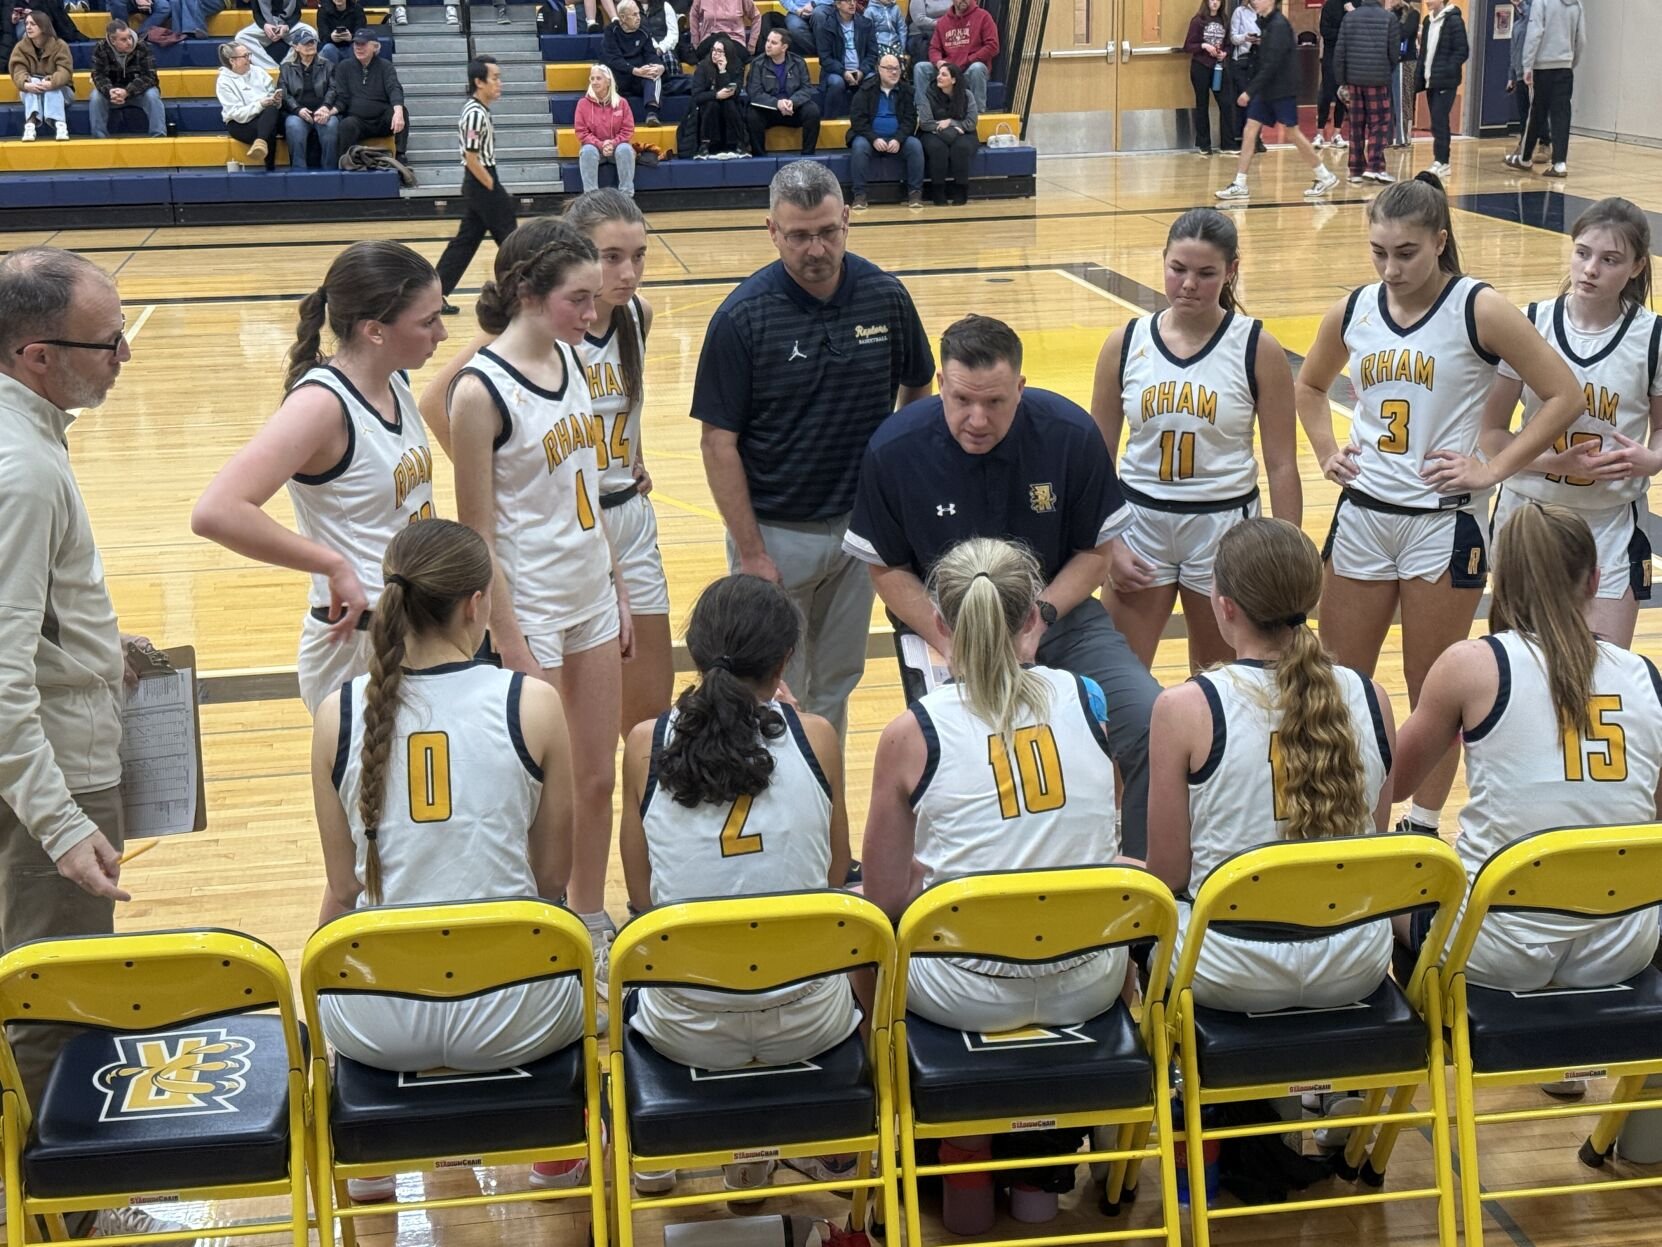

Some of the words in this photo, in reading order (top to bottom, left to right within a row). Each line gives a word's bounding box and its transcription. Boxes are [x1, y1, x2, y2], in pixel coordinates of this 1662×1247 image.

[1360, 348, 1435, 392] RHAM
[1140, 380, 1218, 426] RHAM
[1377, 398, 1411, 456] 3
[1583, 381, 1620, 428] AM
[1158, 429, 1196, 482] 11
[575, 467, 596, 532] 1
[1560, 694, 1629, 783] 15
[406, 730, 453, 824] 0
[987, 722, 1067, 821] 10
[718, 792, 764, 859] 2
